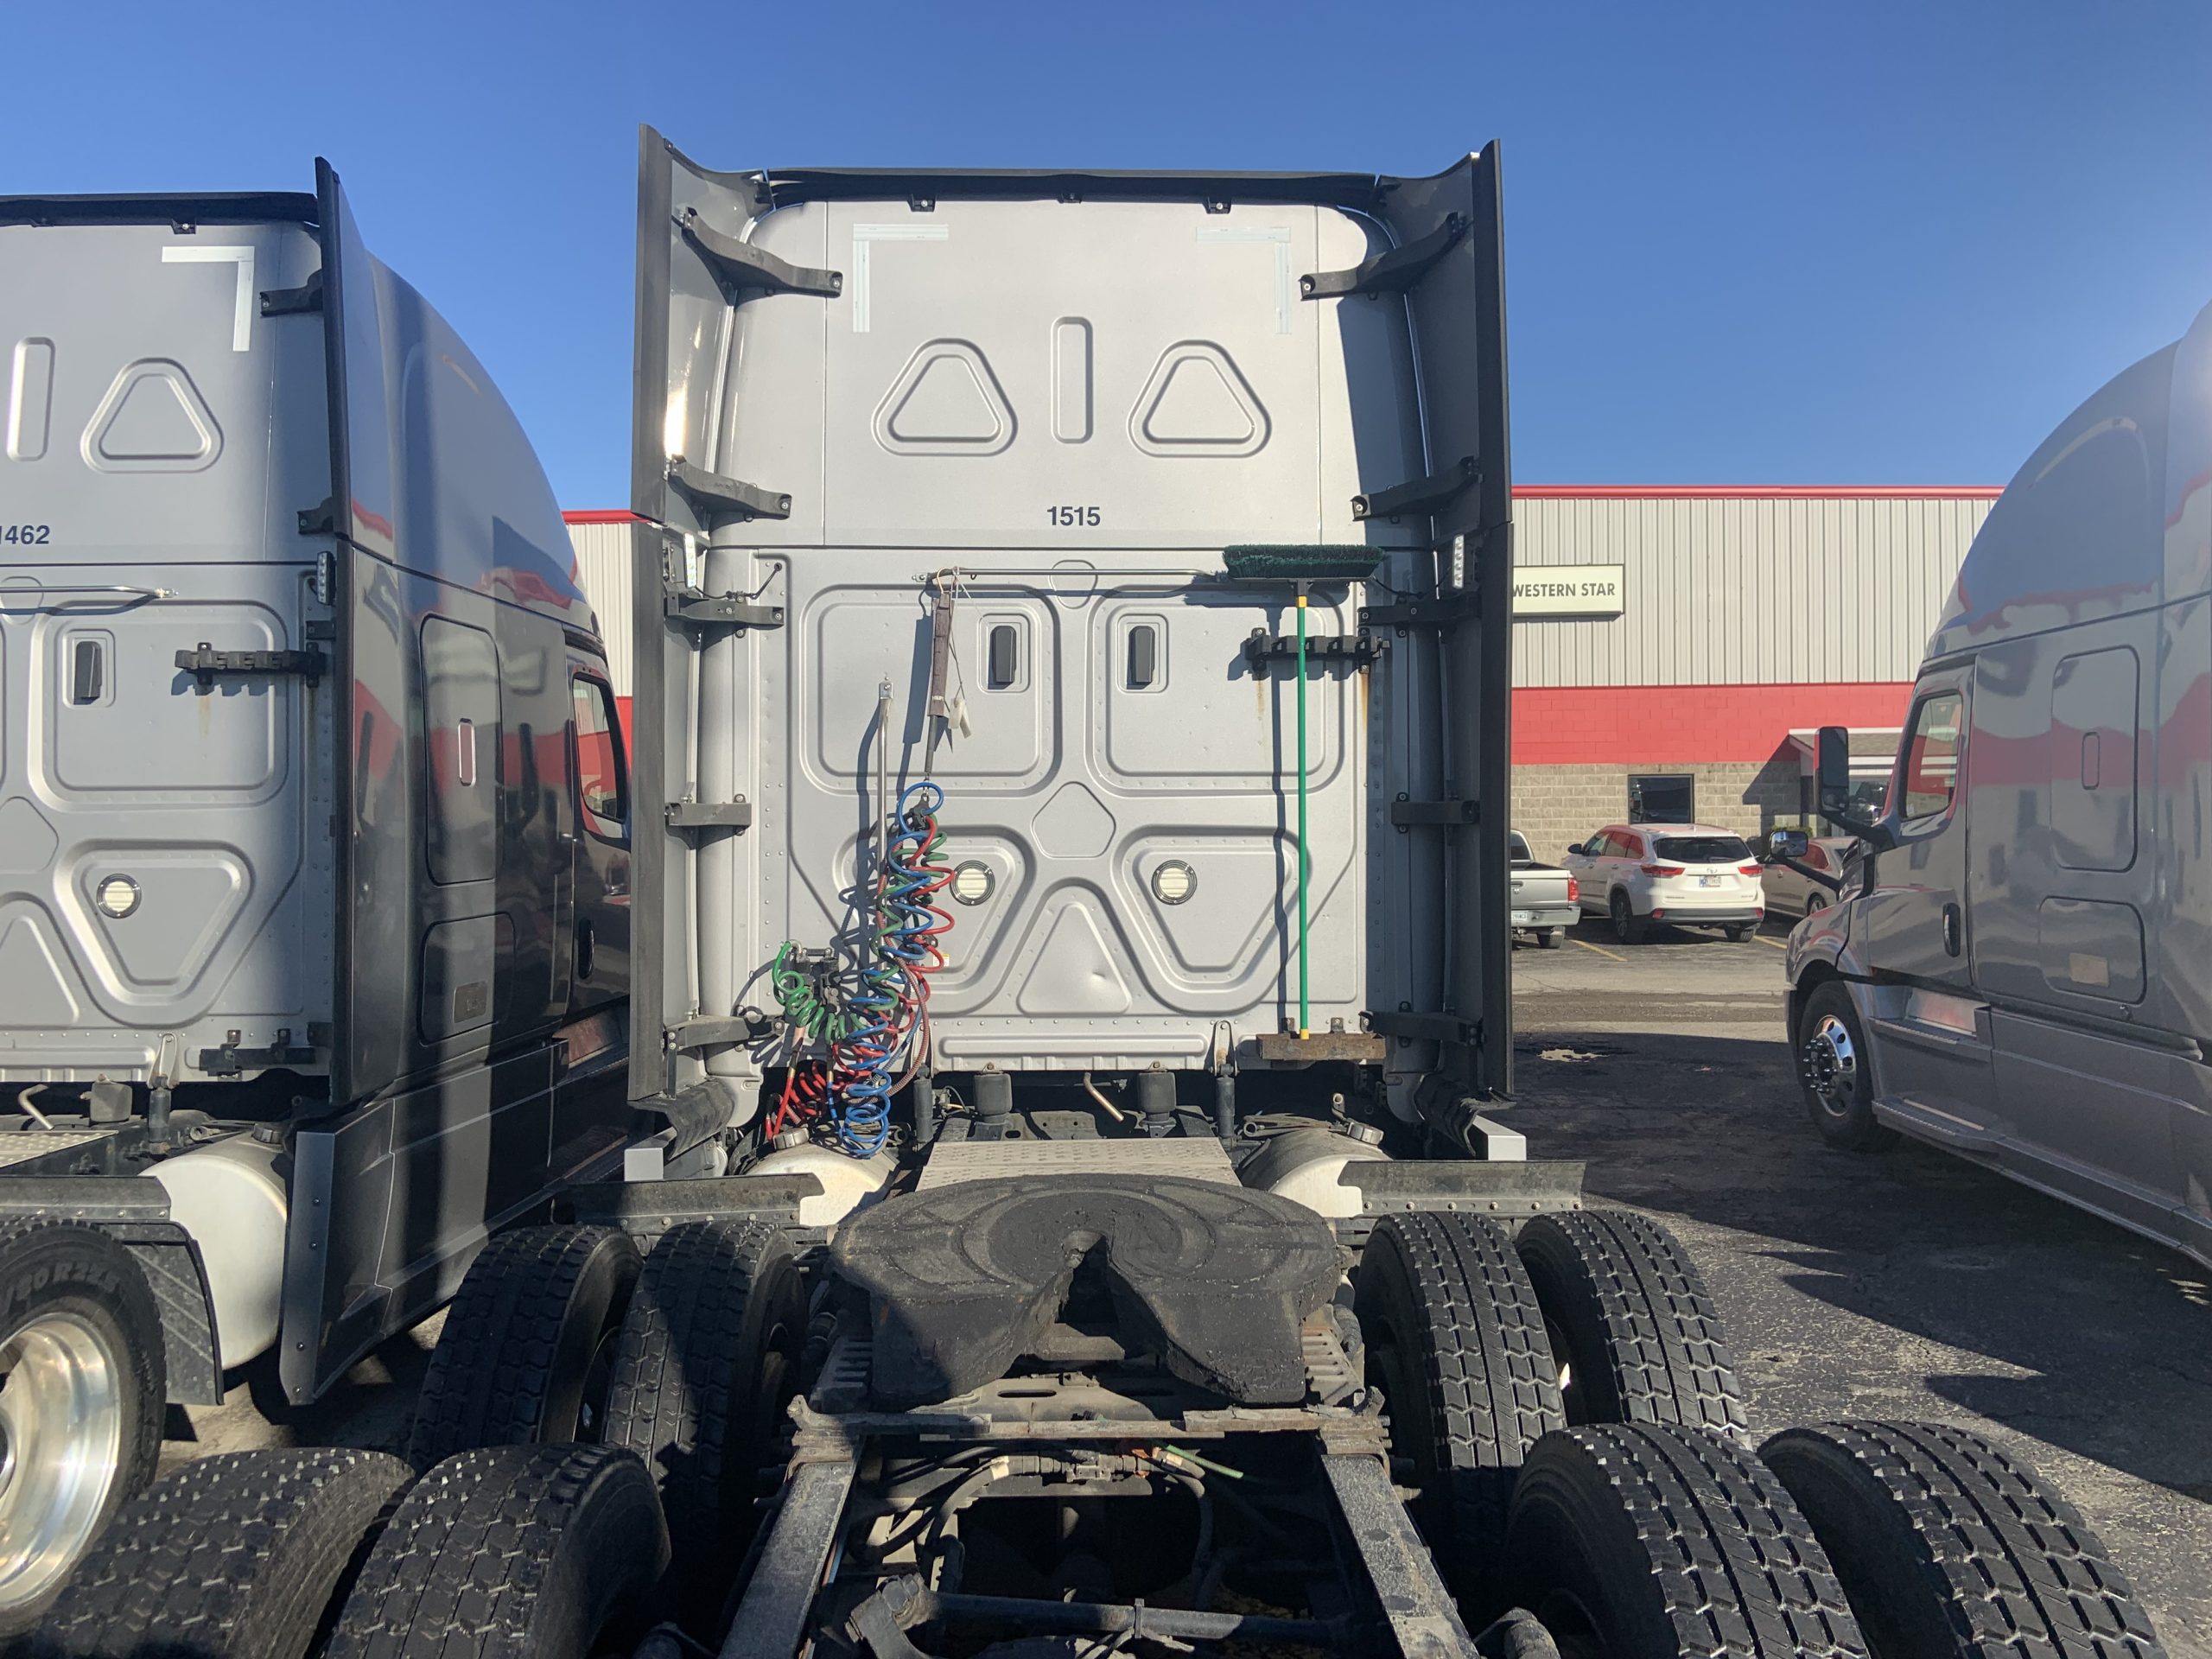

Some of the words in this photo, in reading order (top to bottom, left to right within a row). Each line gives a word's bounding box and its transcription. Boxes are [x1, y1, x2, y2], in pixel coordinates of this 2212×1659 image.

[1047, 506, 1101, 526] 1515
[0, 524, 50, 544] 462
[1513, 583, 1576, 597] WESTERN
[1581, 582, 1616, 596] STAR
